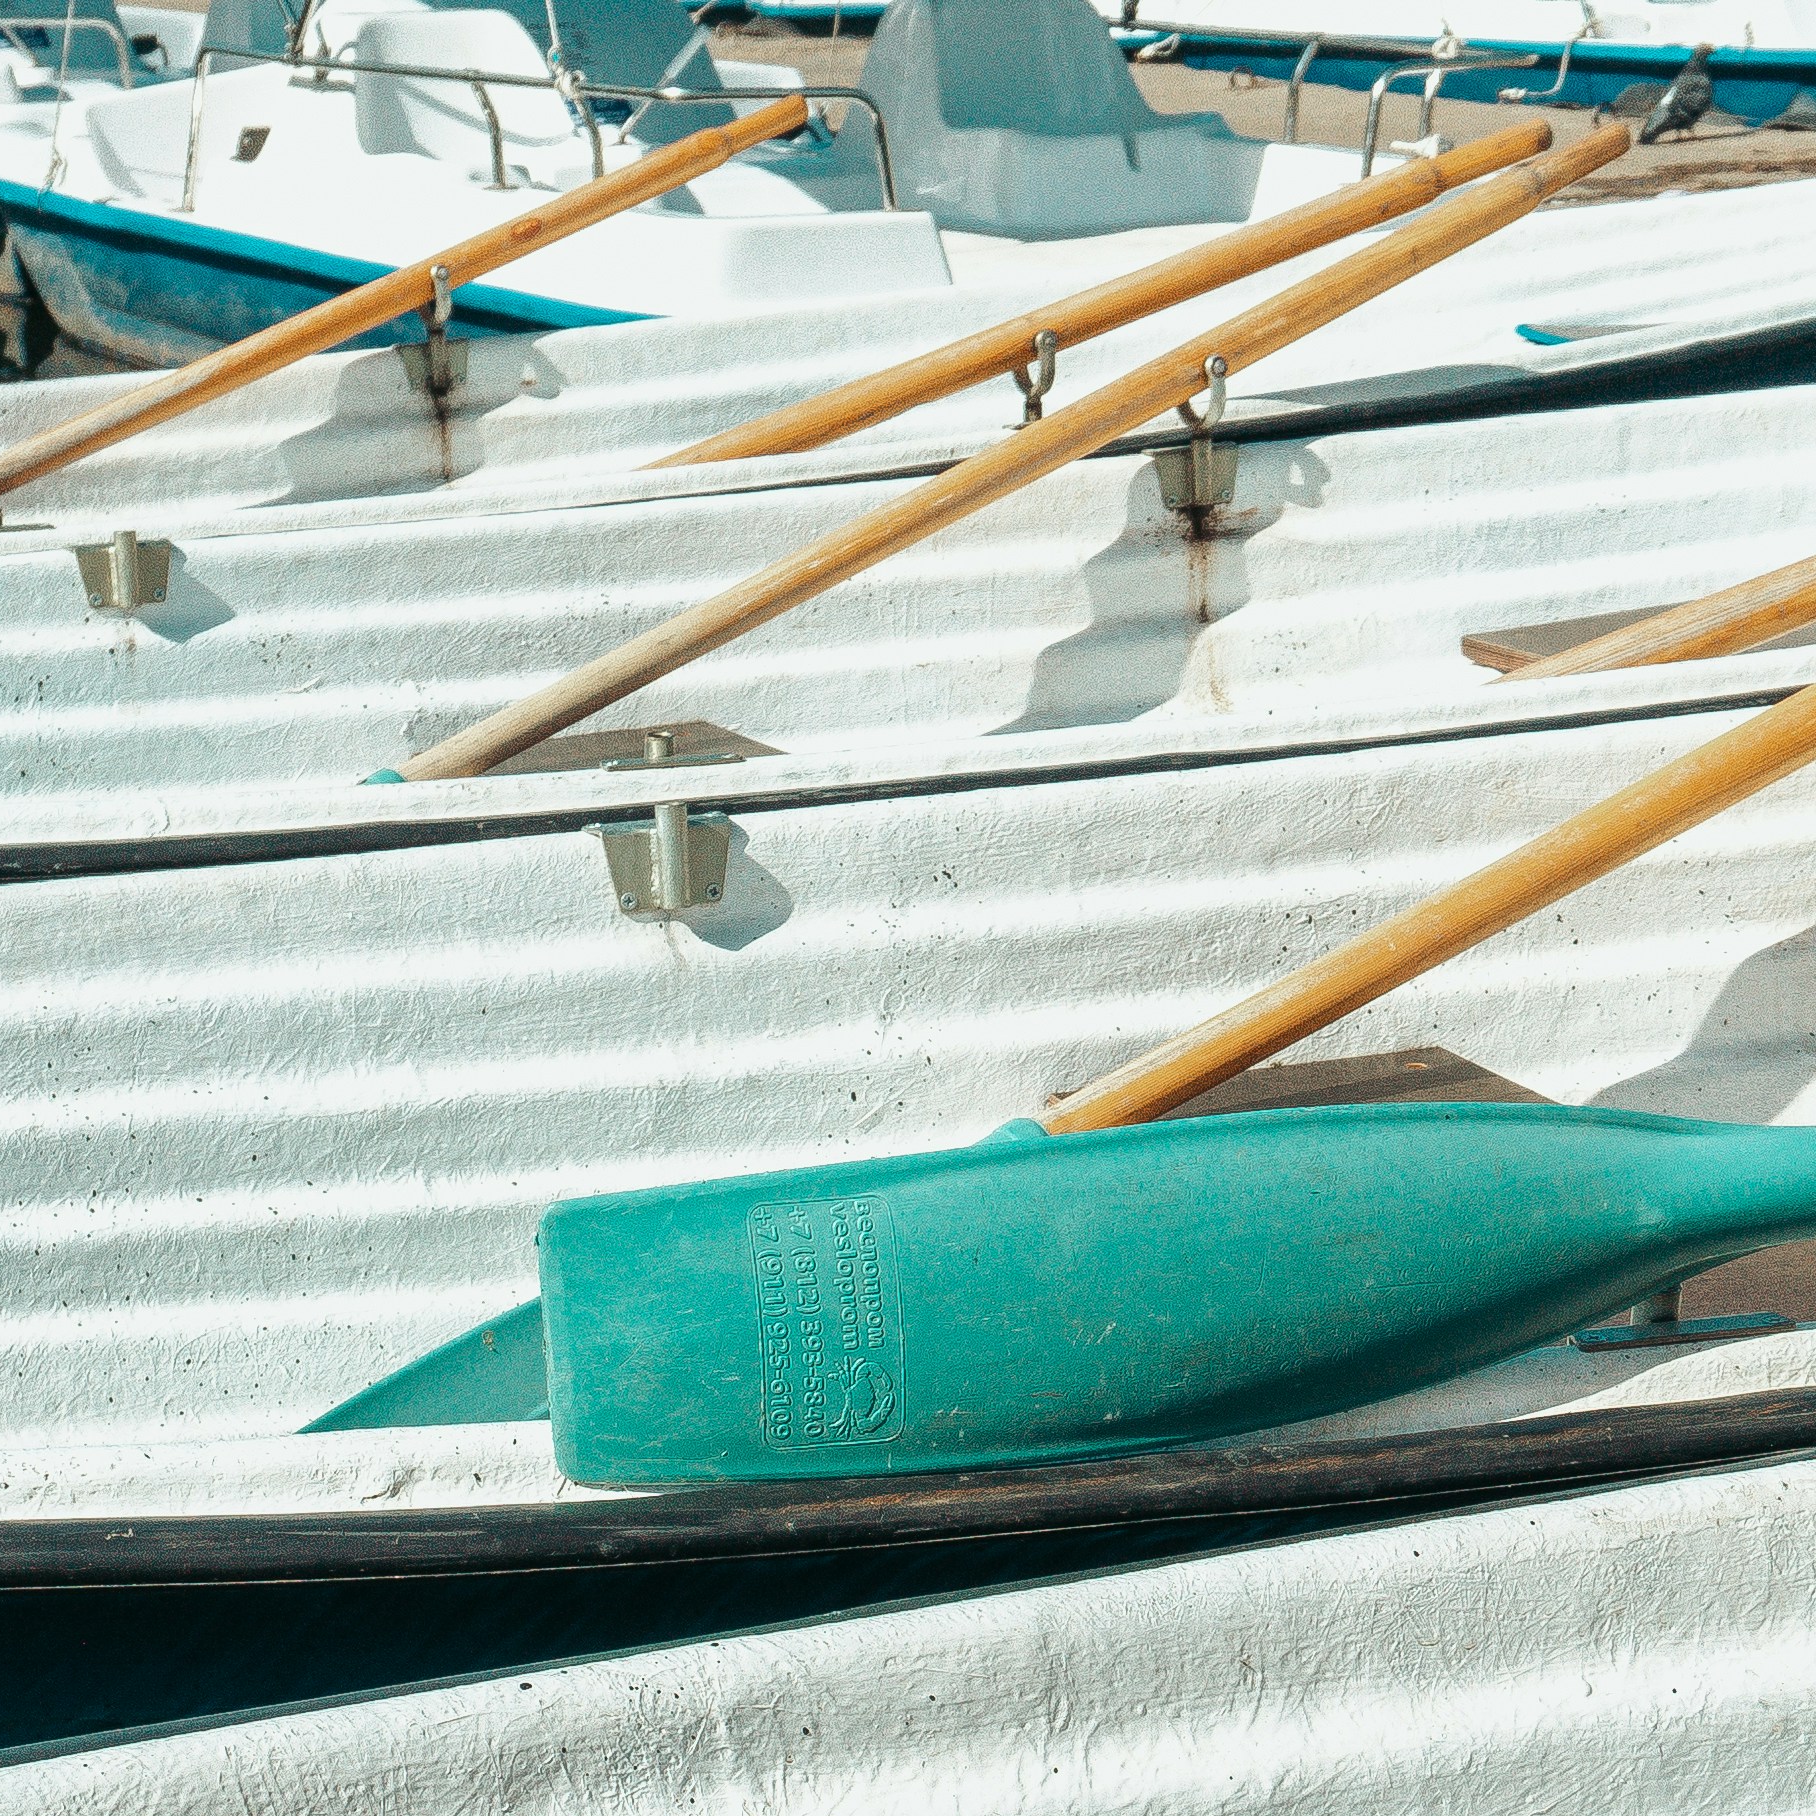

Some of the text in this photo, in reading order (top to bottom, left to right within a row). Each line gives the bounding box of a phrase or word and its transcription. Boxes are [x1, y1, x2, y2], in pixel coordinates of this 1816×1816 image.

[788, 1205, 812, 1241] +7
[830, 1202, 861, 1351] vesloprom
[754, 1206, 793, 1441] +7 (911) 925-6109
[791, 1246, 822, 1315] (812)
